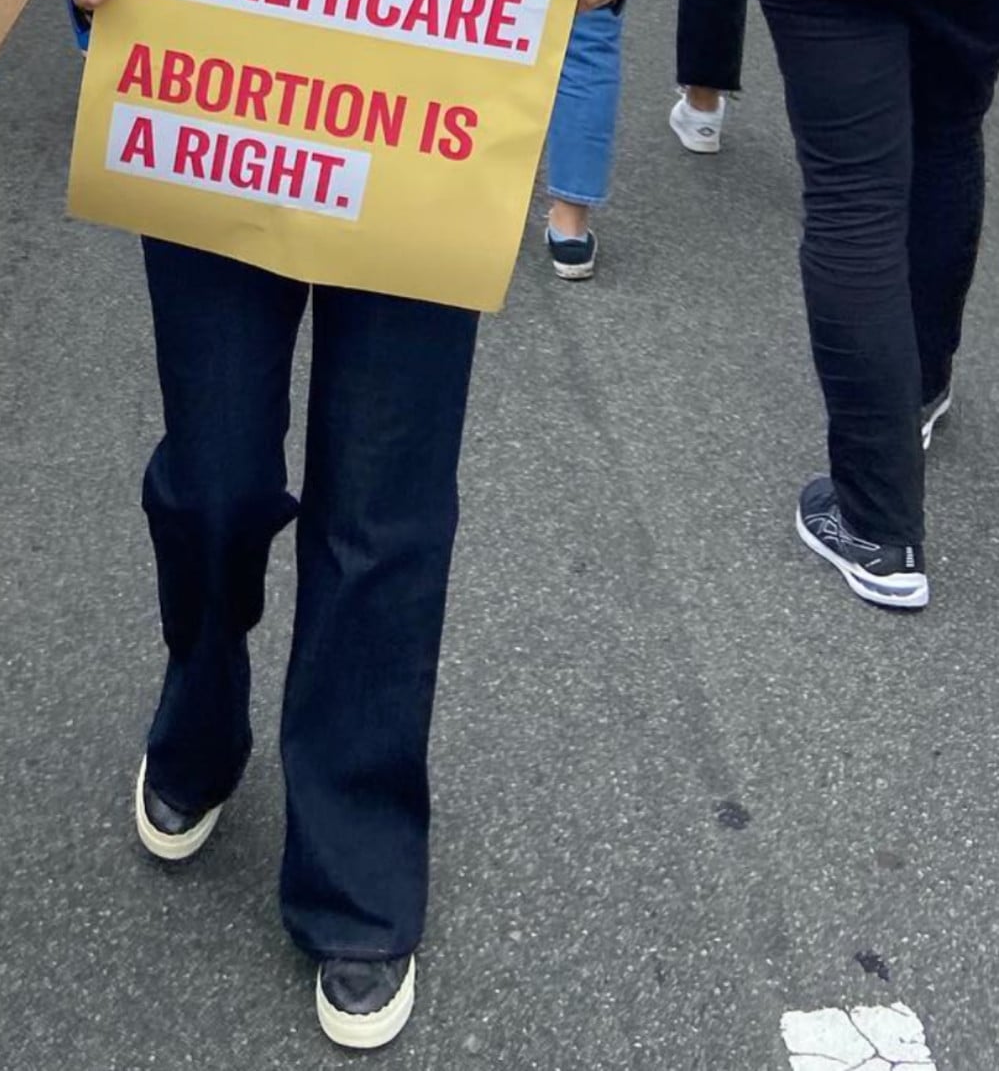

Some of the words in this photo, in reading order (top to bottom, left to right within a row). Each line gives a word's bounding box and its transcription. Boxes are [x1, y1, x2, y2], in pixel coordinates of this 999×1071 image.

[116, 43, 407, 148] ABORTION
[419, 101, 478, 161] IS
[120, 116, 156, 169] A
[173, 125, 349, 208] RIGHT.
